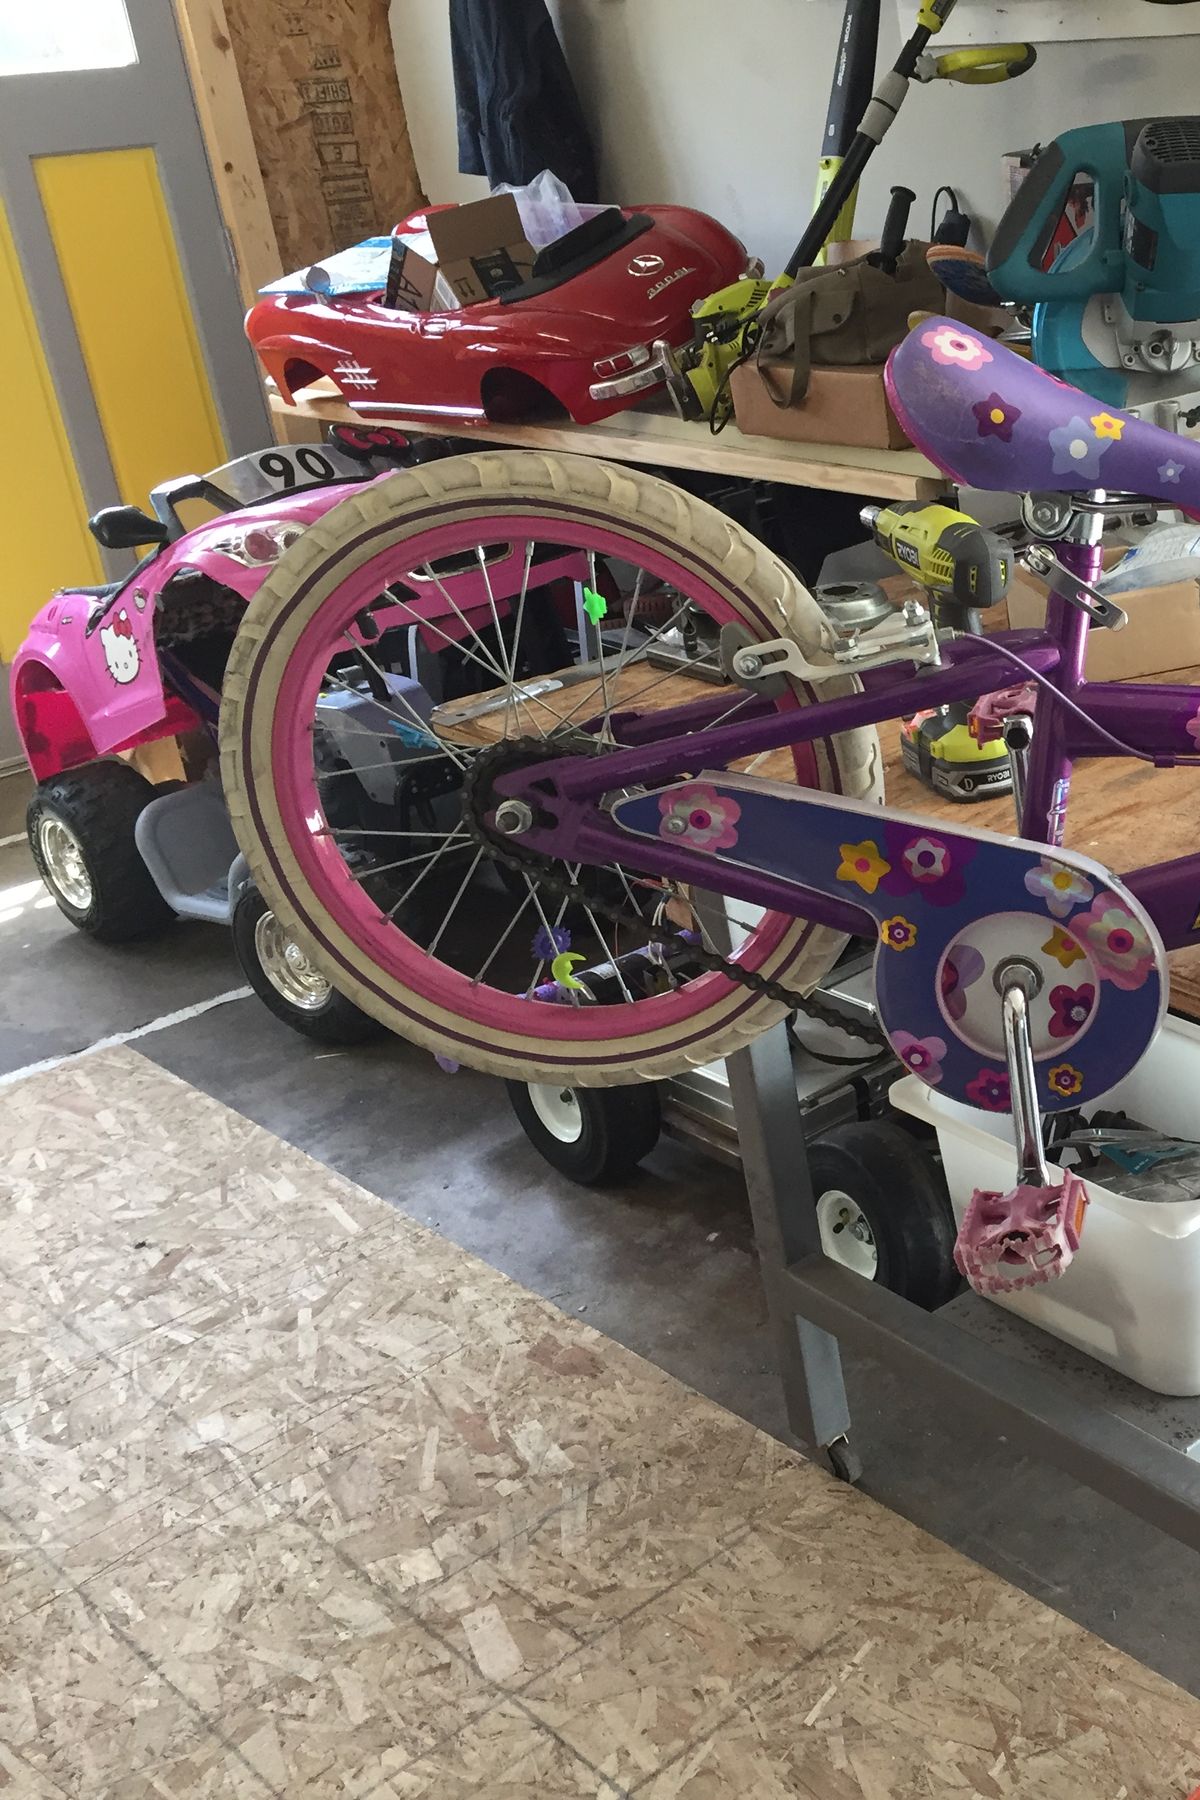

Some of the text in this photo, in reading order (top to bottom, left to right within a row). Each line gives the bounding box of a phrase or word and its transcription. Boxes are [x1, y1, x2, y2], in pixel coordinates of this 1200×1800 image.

[259, 448, 335, 488] 90
[896, 542, 919, 566] RYOBI
[987, 770, 1010, 782] RYOBI
